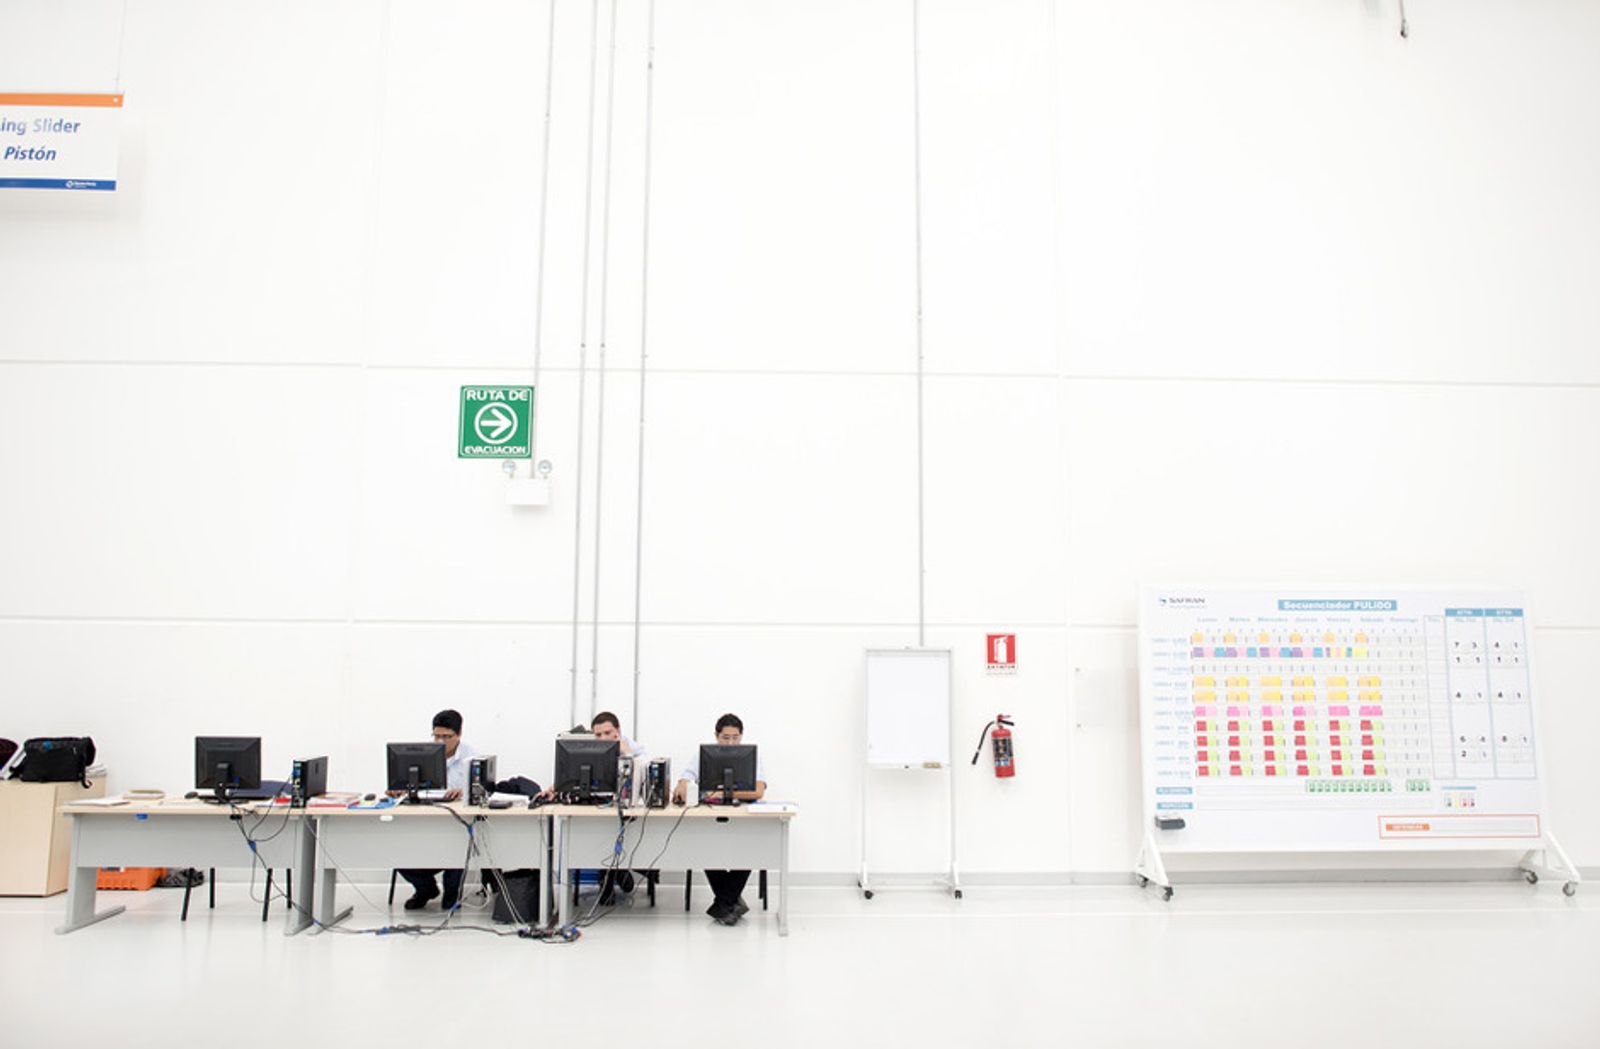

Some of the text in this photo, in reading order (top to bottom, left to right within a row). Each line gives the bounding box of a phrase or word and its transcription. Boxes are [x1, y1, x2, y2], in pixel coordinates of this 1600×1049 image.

[0, 117, 81, 135] ing Slider
[4, 145, 57, 160] Pistón
[466, 389, 528, 401] RUTA DE
[1283, 601, 1351, 609] Secuenciador
